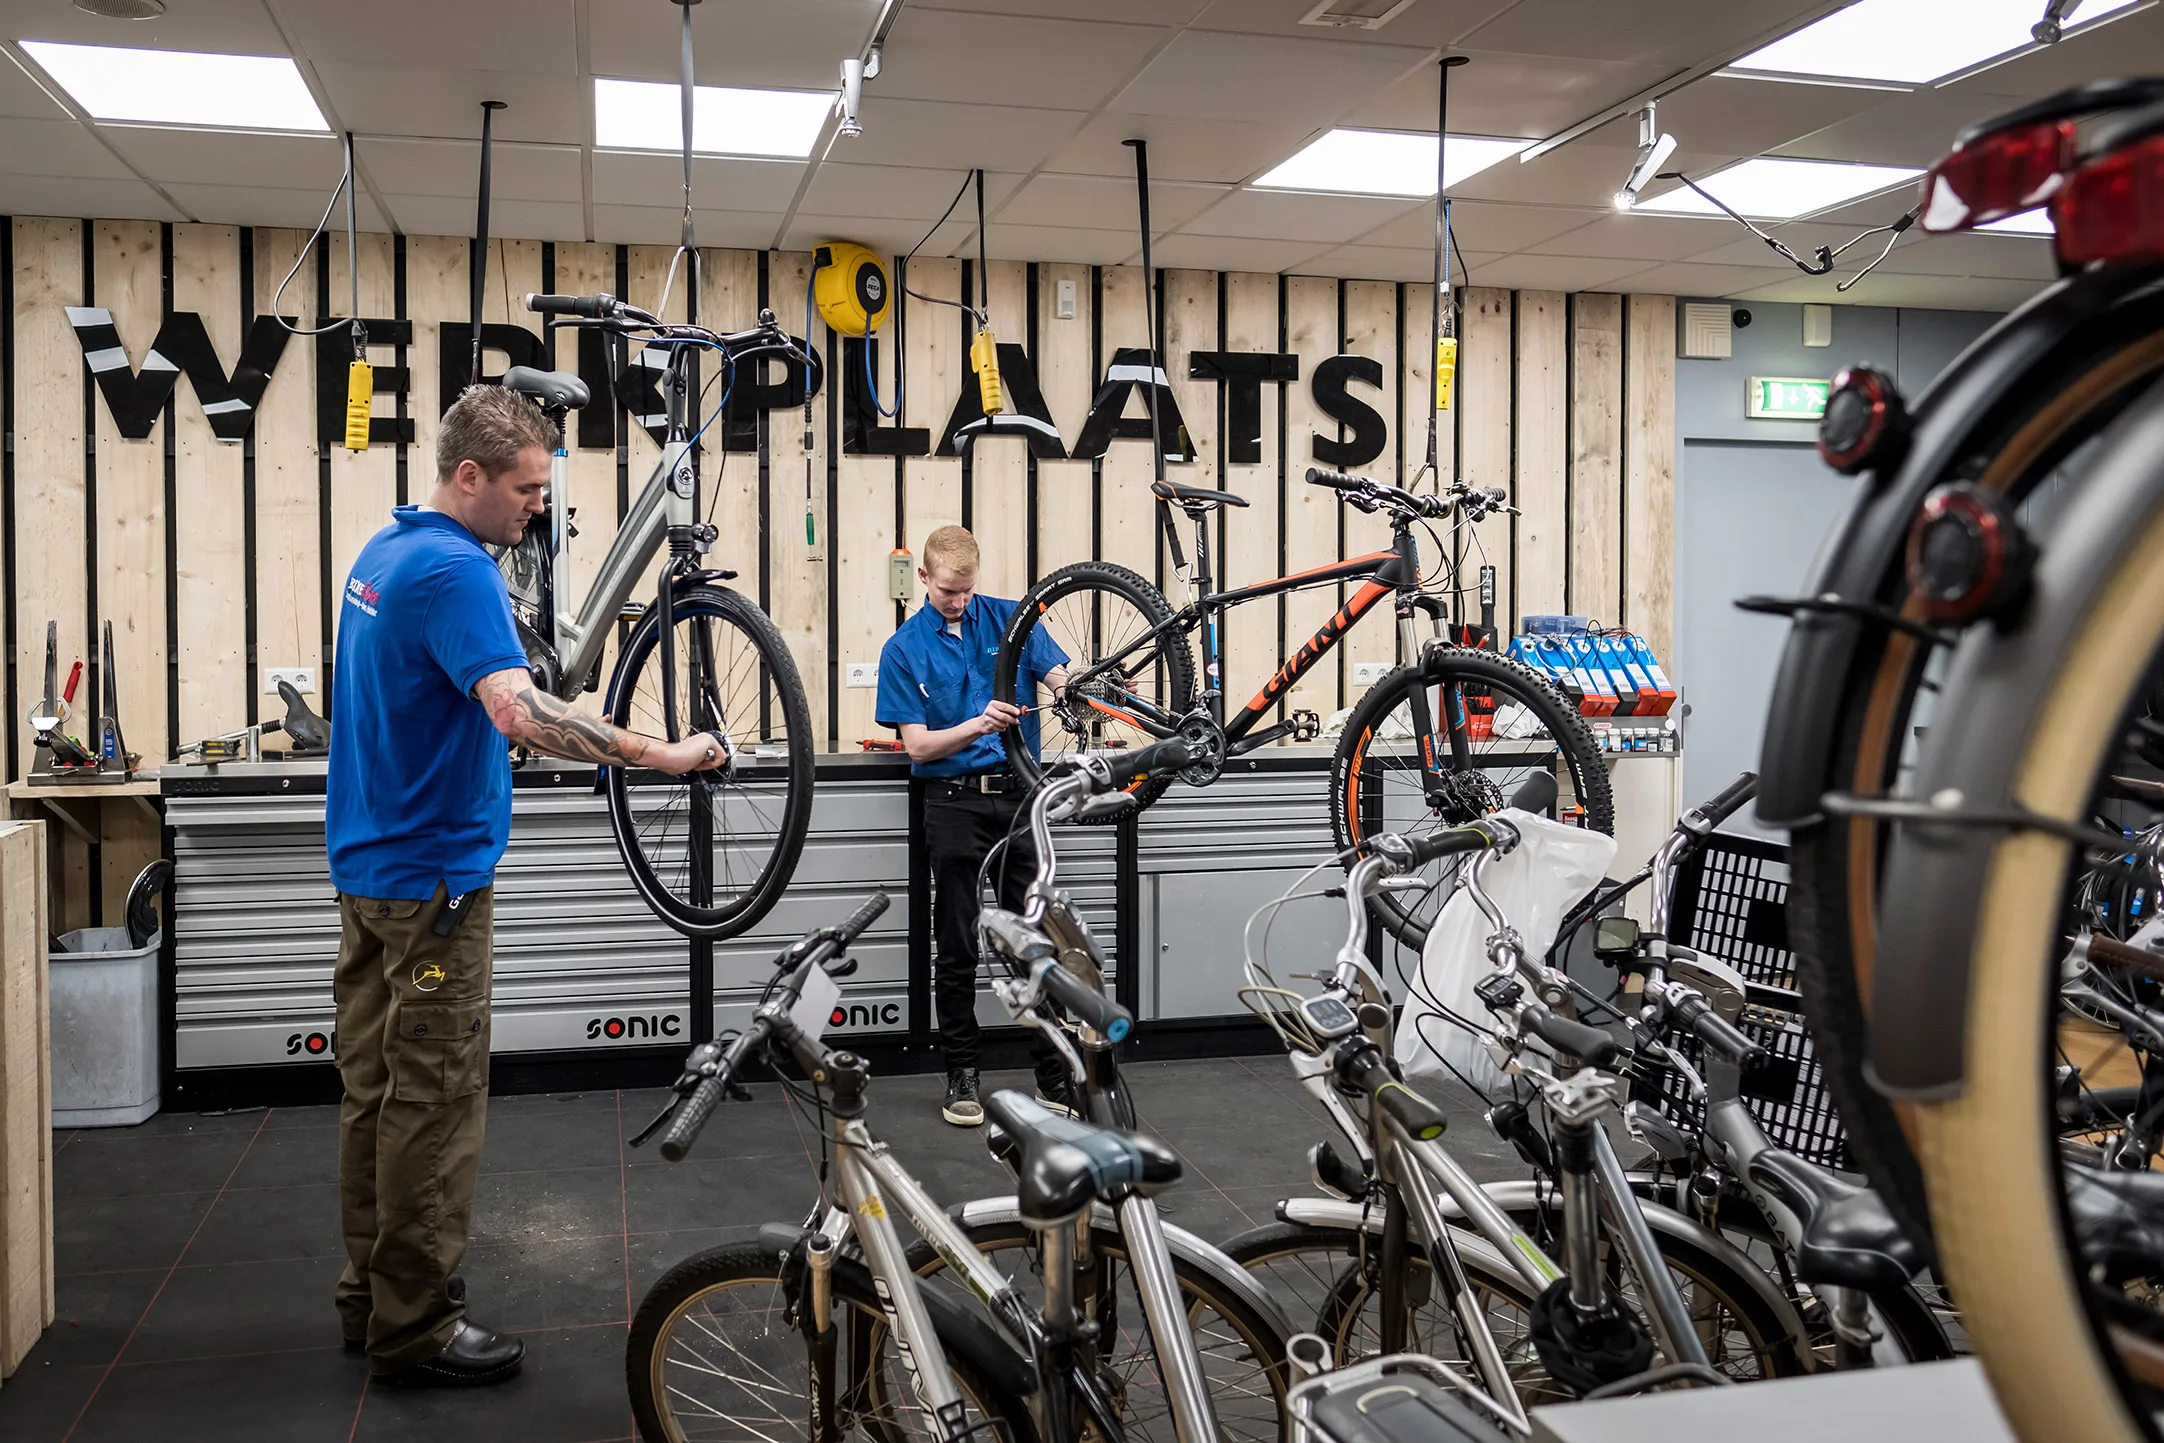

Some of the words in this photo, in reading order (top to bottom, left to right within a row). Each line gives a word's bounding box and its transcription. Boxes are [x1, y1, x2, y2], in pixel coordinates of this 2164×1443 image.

[1007, 604, 1031, 644] SCHWALBE
[1035, 582, 1056, 600] SMART
[1057, 576, 1072, 586] SAM
[1262, 603, 1356, 700] GIANT
[1337, 757, 1350, 846] SCHWALBE
[587, 1014, 680, 1040] SONIC
[828, 1003, 900, 1027] ONIC
[287, 1031, 335, 1056] SO
